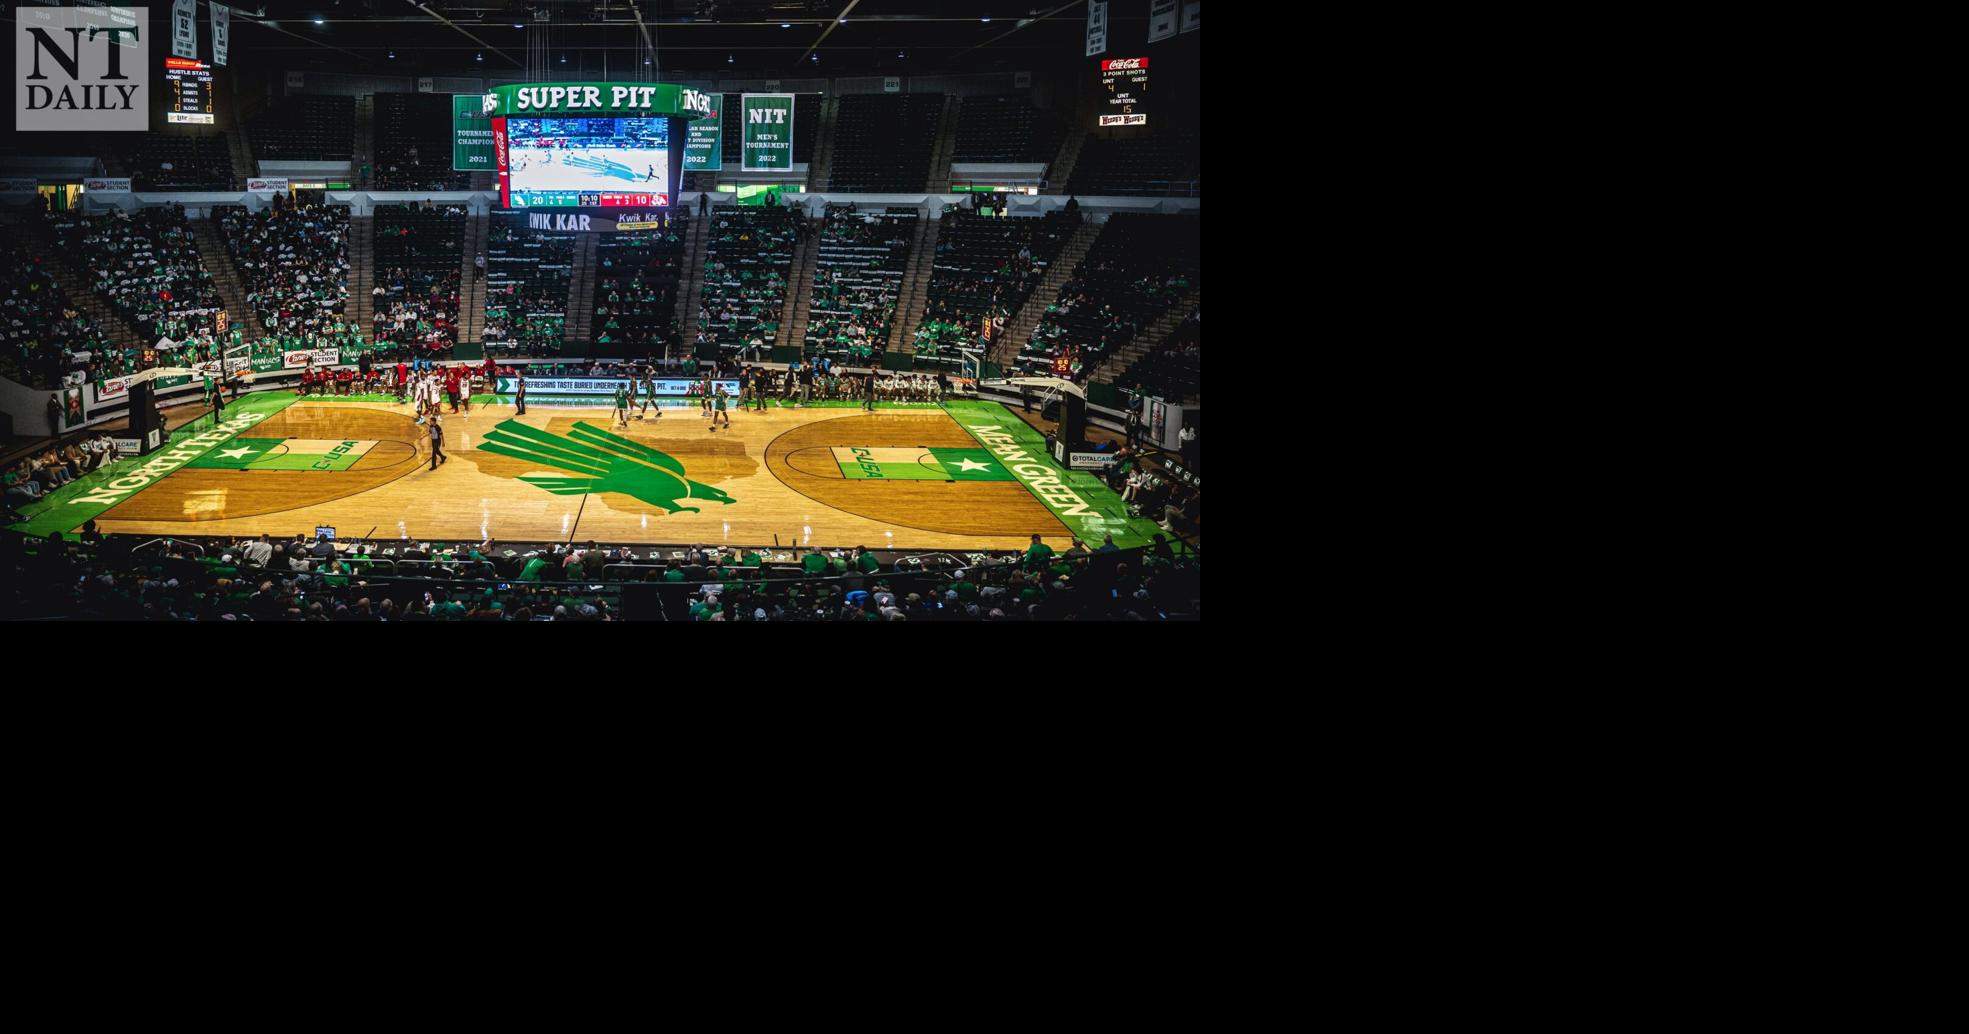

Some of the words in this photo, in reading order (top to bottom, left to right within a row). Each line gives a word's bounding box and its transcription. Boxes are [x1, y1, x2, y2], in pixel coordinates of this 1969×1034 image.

[206, 82, 212, 90] 3
[517, 86, 603, 110] SUPER
[611, 86, 657, 108] PIT
[174, 104, 180, 112] 0
[206, 104, 212, 113] 0
[1123, 105, 1132, 114] 15
[749, 108, 786, 124] NIT
[532, 196, 544, 204] 20
[636, 196, 647, 204] 10
[556, 213, 591, 231] KAR
[619, 213, 641, 223] Kwik
[311, 350, 338, 358] STUDENT
[574, 382, 593, 390] BURIED
[175, 412, 266, 449] TEXAS
[967, 425, 1038, 463] MEAN
[67, 450, 202, 506] NORTH
[1012, 463, 1104, 519] GREEN
